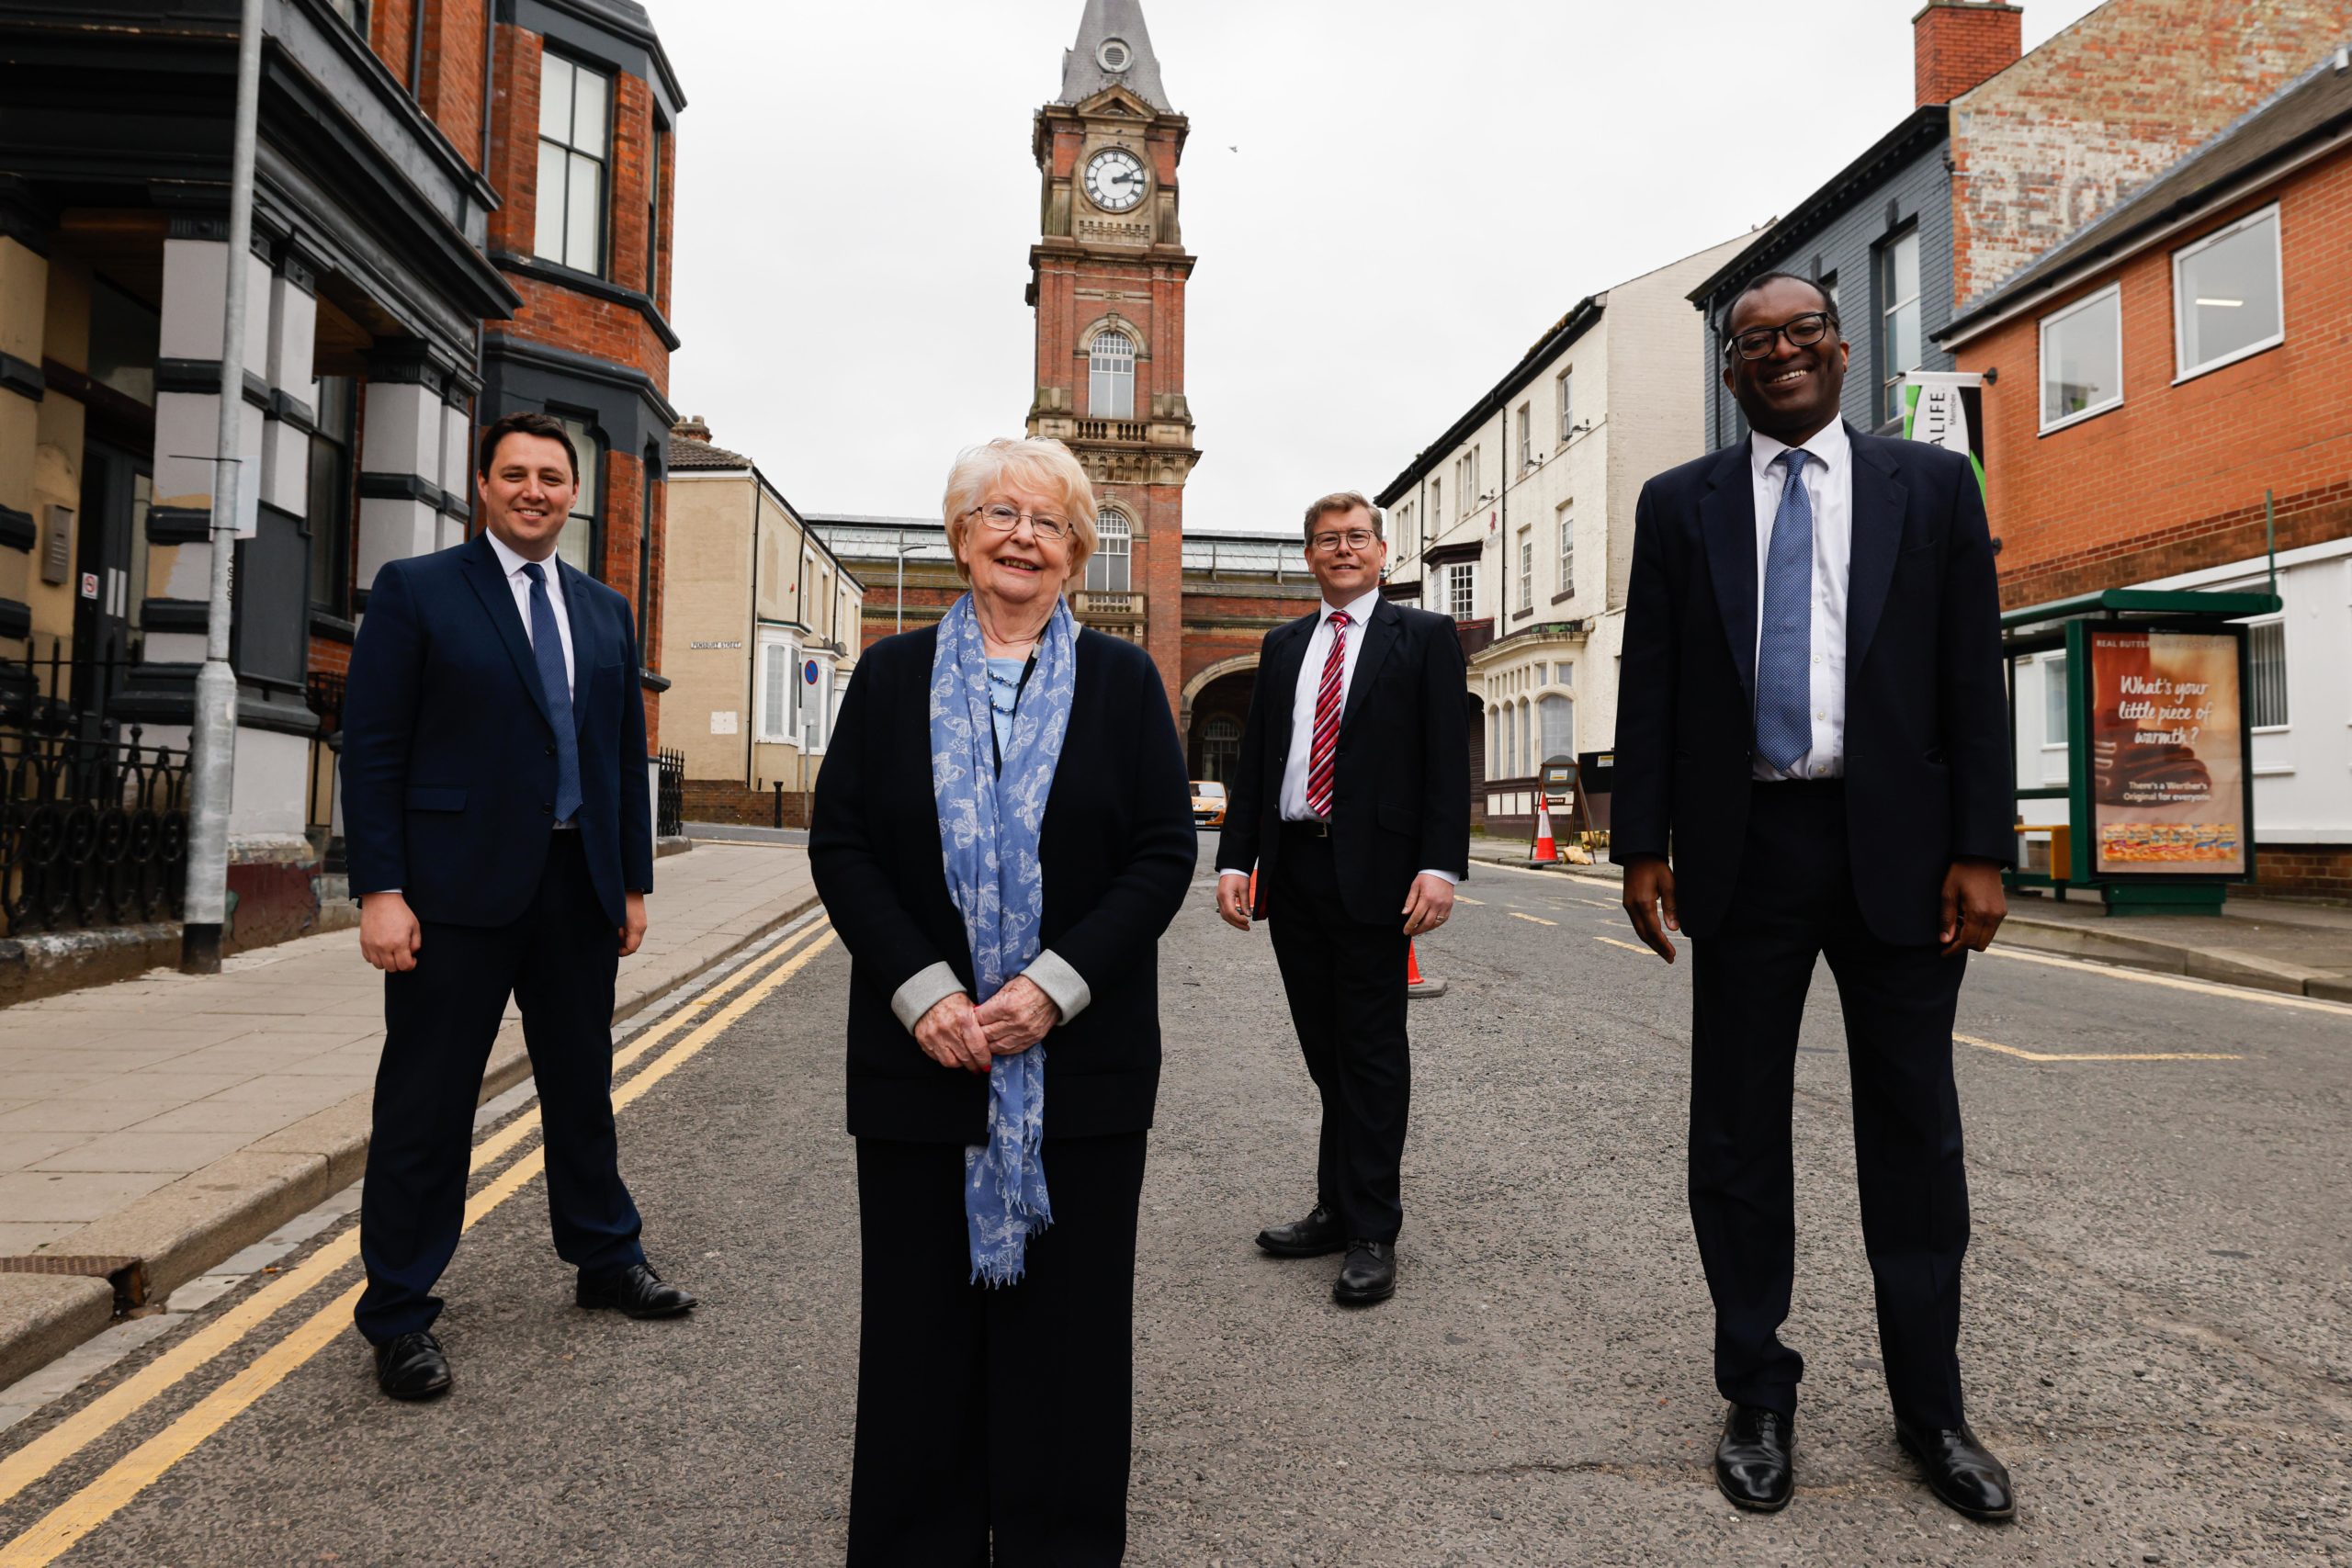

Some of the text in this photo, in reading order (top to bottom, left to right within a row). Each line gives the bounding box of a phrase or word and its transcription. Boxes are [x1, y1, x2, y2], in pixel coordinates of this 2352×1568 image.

[2097, 639, 2117, 648] REAL
[2120, 675, 2209, 705] What's your
[2118, 700, 2213, 726] little piece of
[2129, 782, 2158, 790] There's
[2165, 781, 2208, 790] Werther's
[2122, 792, 2157, 803] Original
[2158, 792, 2171, 801] for
